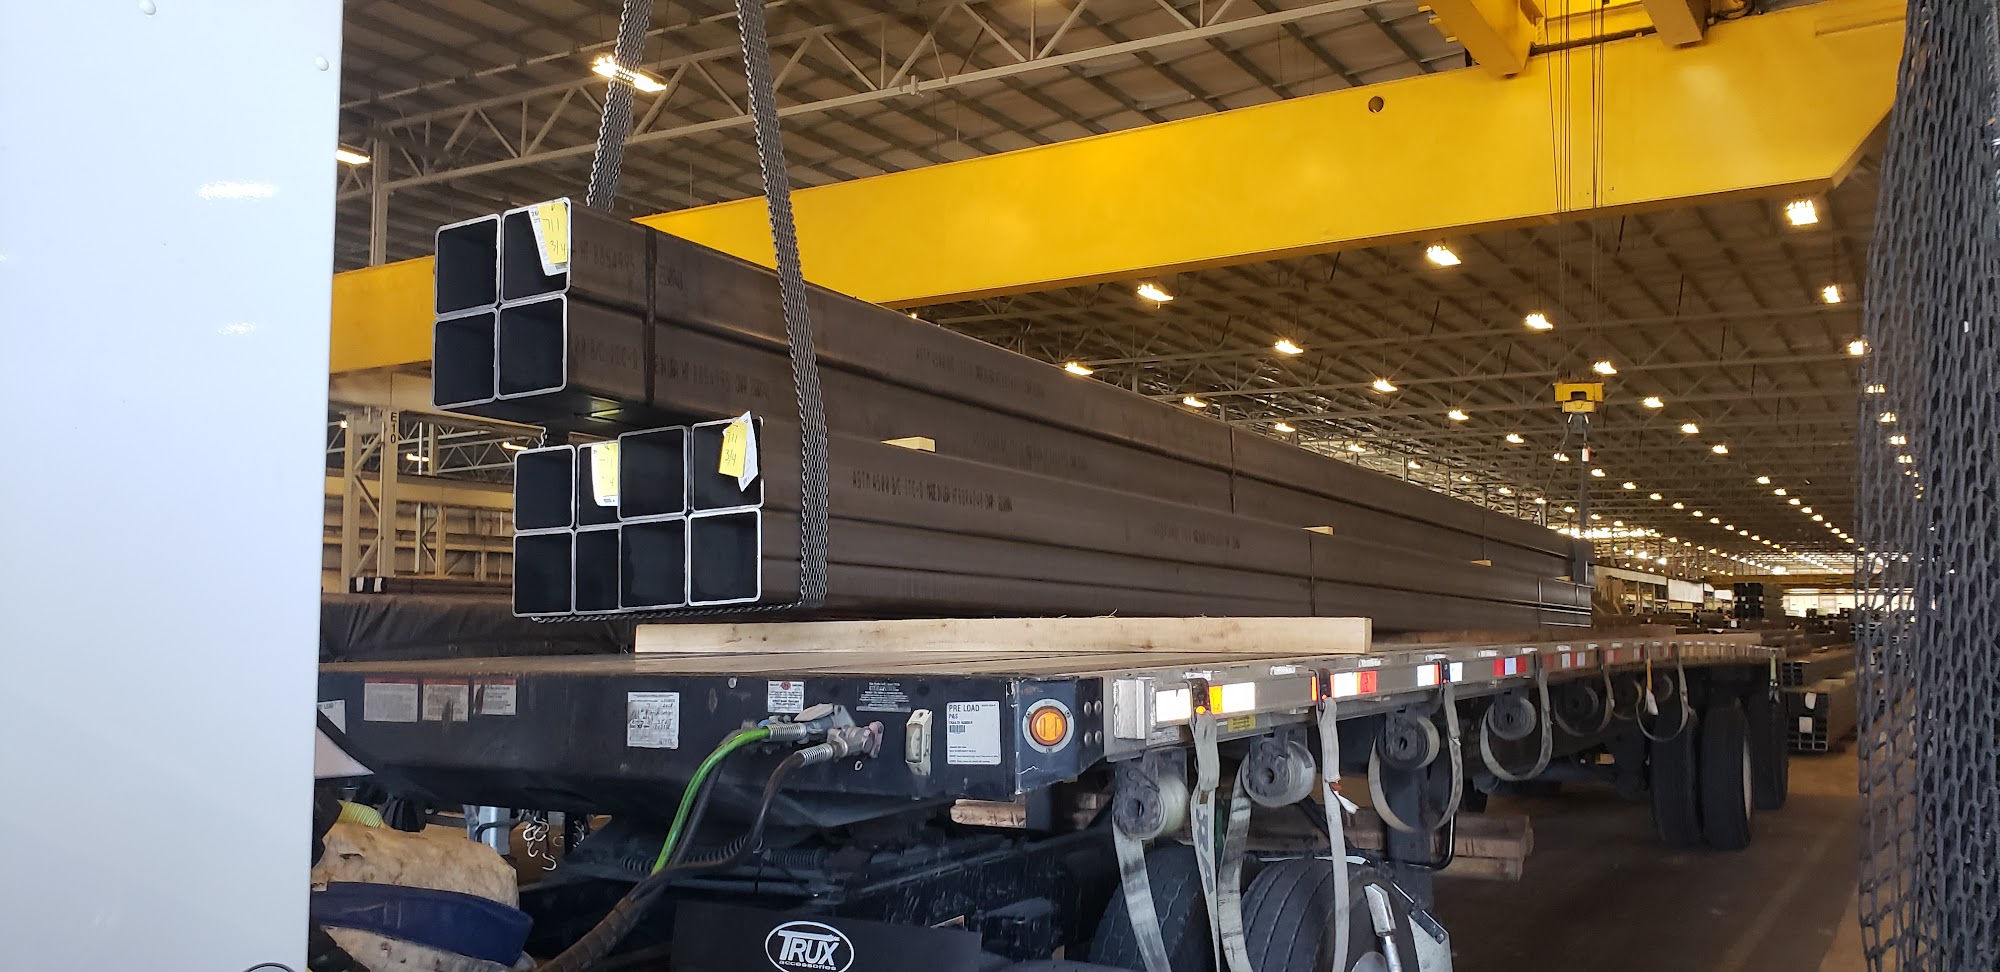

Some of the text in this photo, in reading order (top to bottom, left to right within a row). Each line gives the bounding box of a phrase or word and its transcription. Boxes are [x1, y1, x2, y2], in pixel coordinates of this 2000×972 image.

[549, 239, 566, 256] 3/4
[948, 704, 980, 712] PRE LOAD
[777, 929, 840, 966] TRUX
[778, 960, 837, 971] accessories
